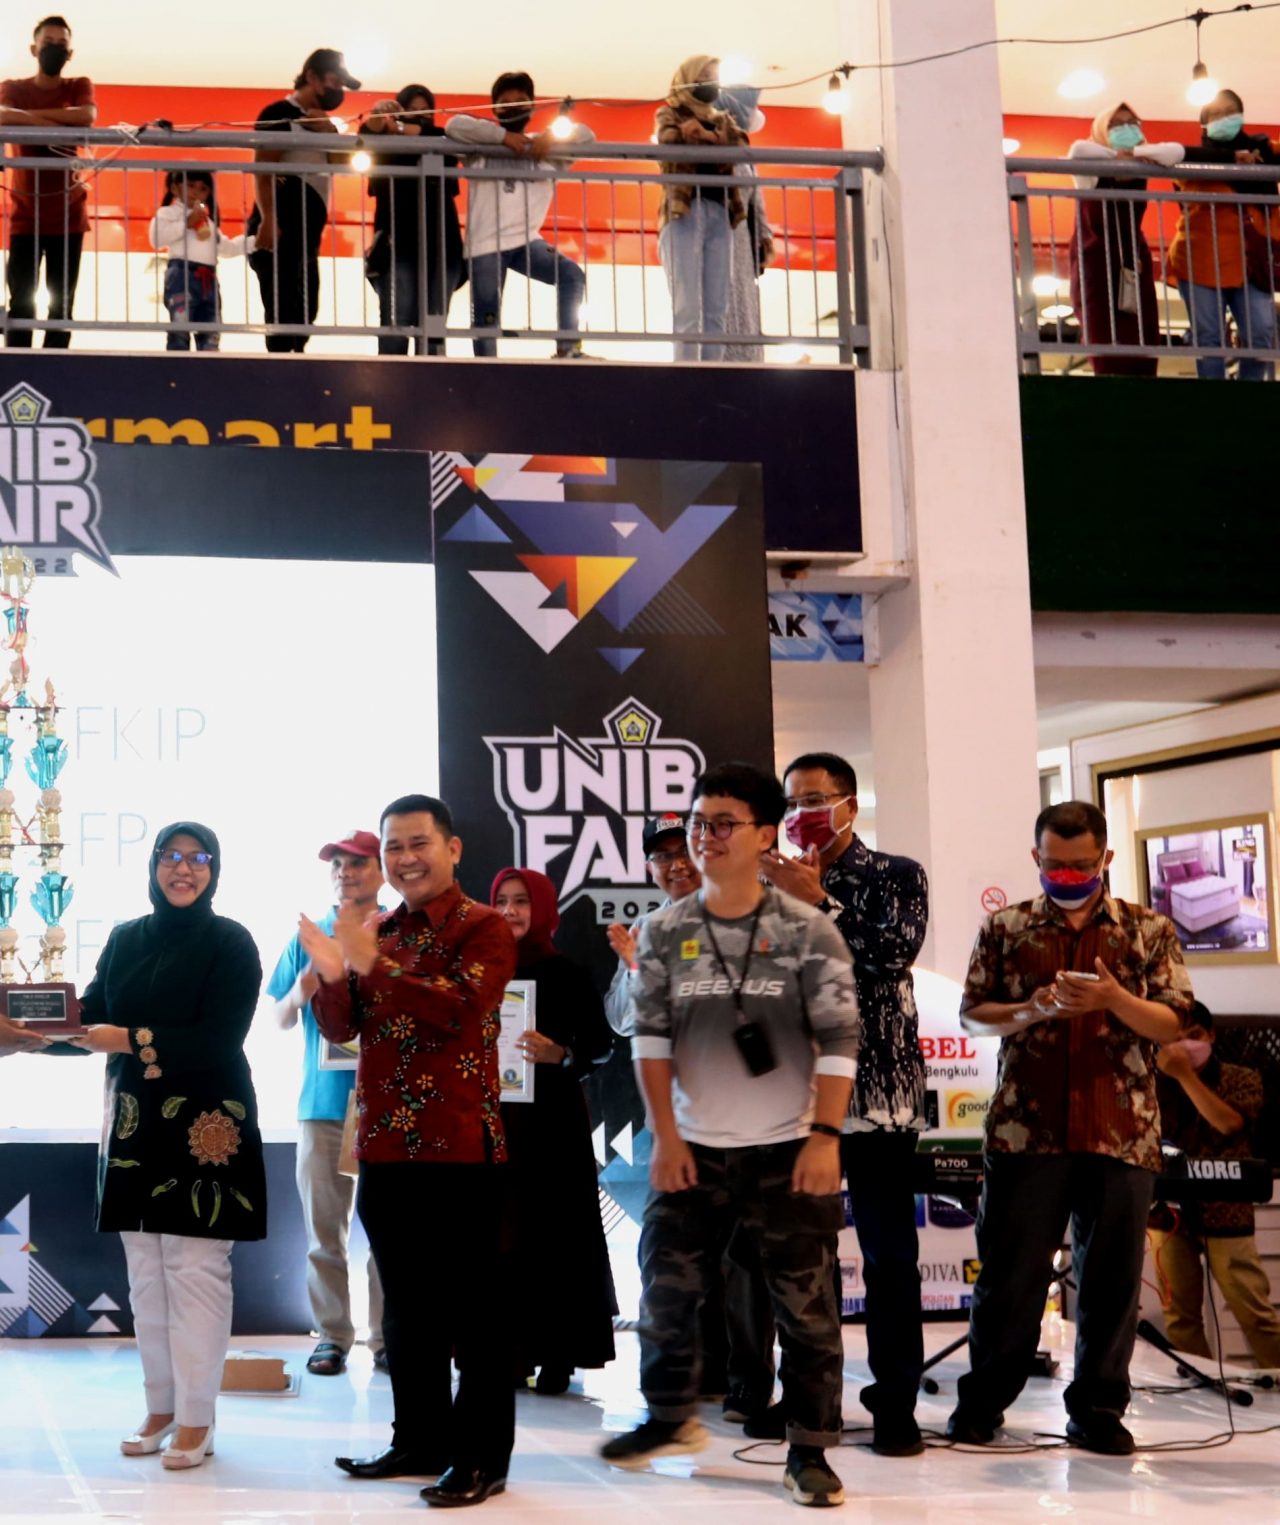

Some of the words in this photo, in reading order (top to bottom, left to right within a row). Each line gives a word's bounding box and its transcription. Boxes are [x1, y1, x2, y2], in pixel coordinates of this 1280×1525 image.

[76, 706, 207, 761] FKIP
[503, 747, 697, 813] UNIB
[80, 812, 148, 868] FP
[925, 1066, 978, 1079] Bengkulu
[934, 1158, 968, 1169] Pa700
[1187, 1160, 1242, 1180] KORG
